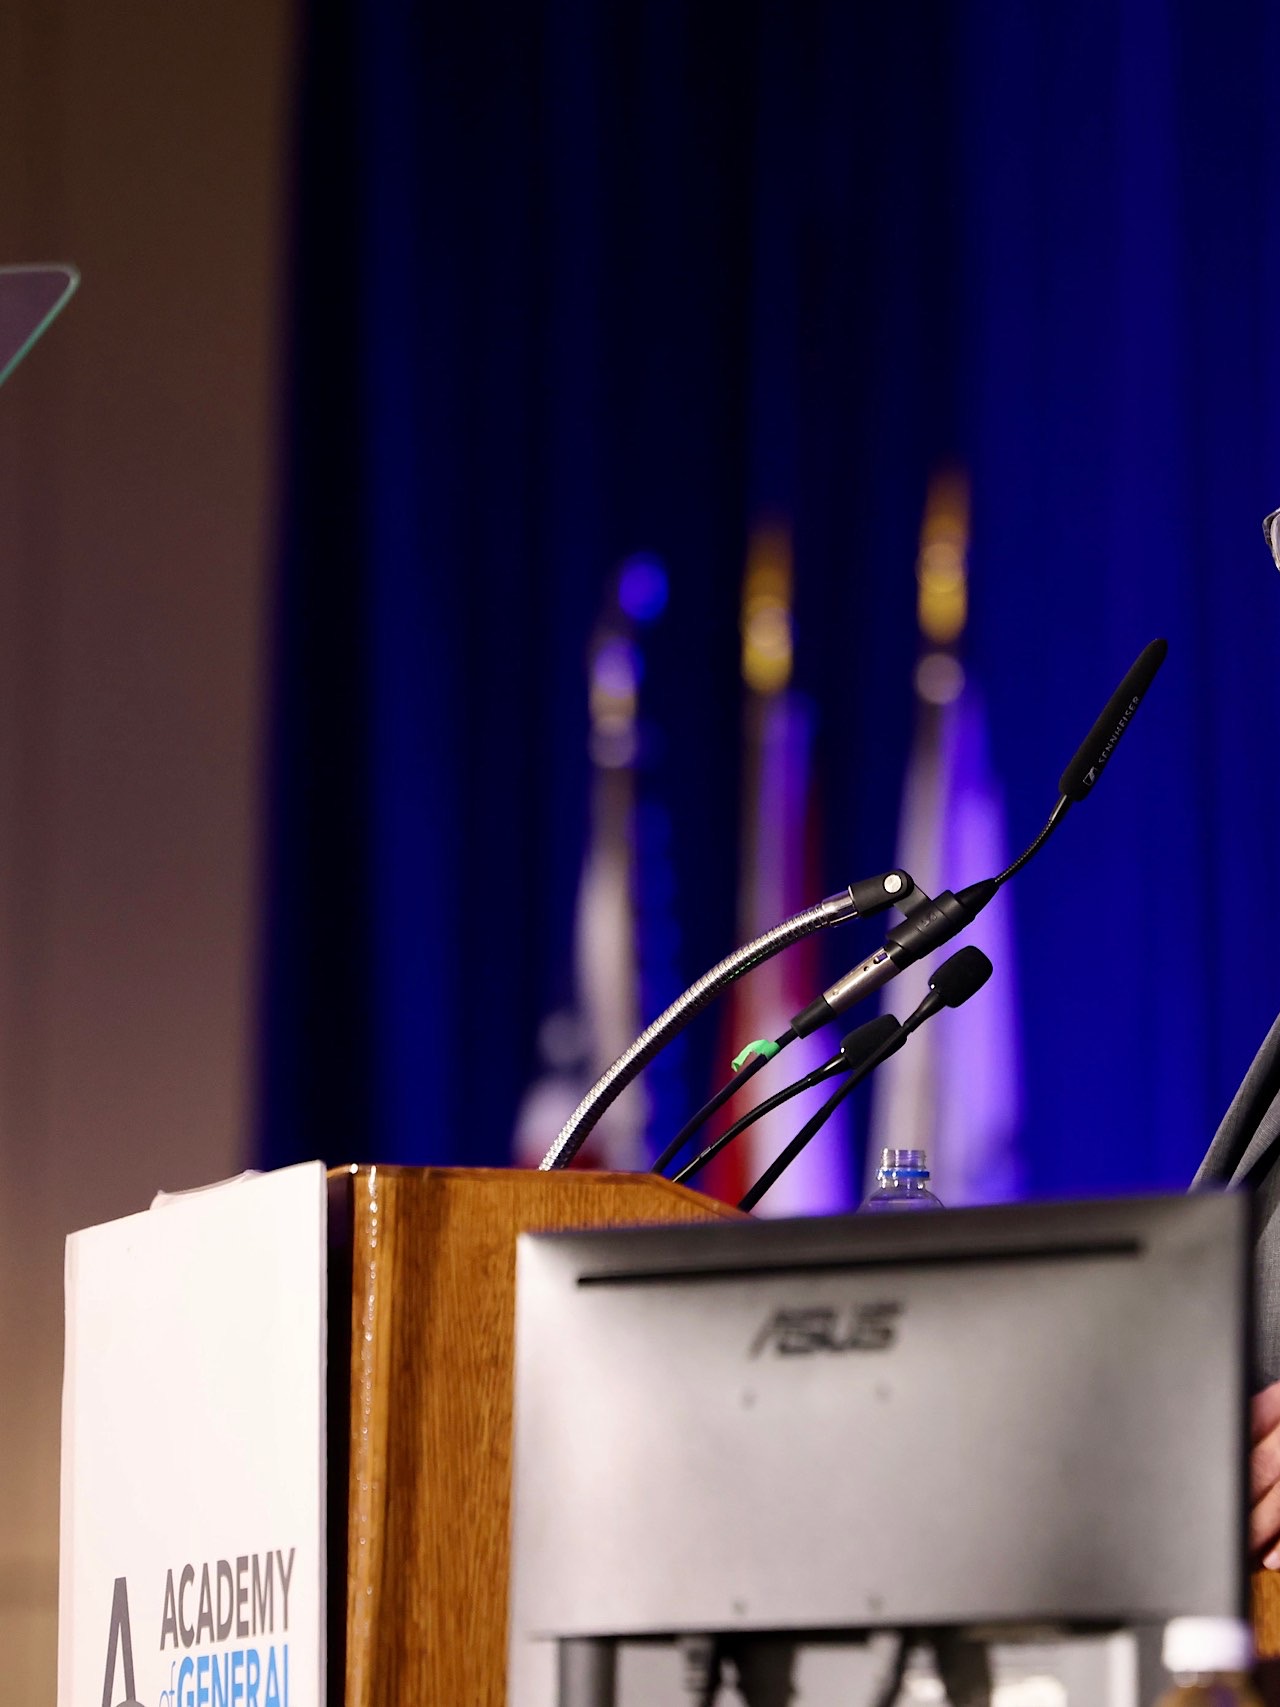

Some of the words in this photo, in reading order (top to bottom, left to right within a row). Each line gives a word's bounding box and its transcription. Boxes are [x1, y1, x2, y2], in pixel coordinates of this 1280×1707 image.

[1098, 696, 1140, 764] SENNHEISER
[748, 1301, 903, 1359] ASUS
[159, 1547, 296, 1651] ACADEMY
